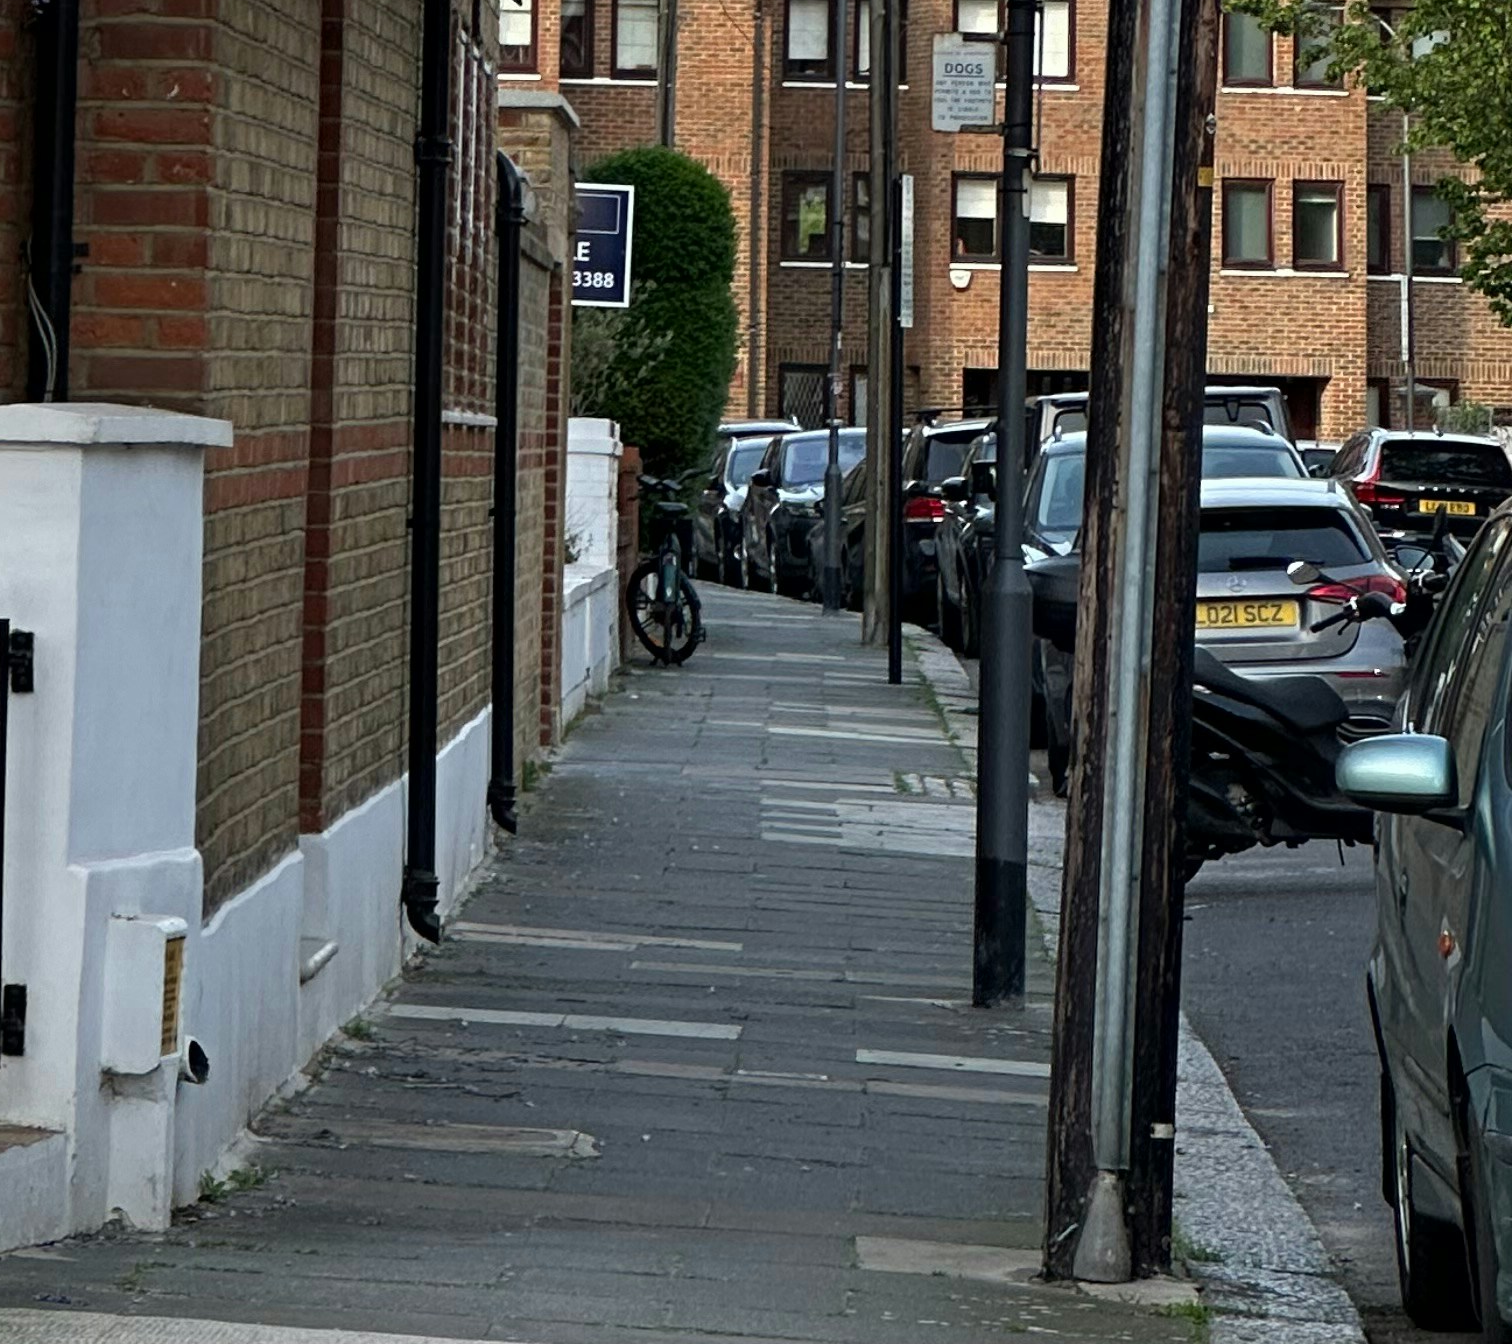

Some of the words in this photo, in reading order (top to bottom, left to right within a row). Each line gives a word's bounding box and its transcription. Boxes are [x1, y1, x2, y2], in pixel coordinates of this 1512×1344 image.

[944, 62, 984, 74] DOGS
[574, 241, 591, 262] E
[572, 270, 615, 289] 3388
[1243, 604, 1284, 623] SCZ
